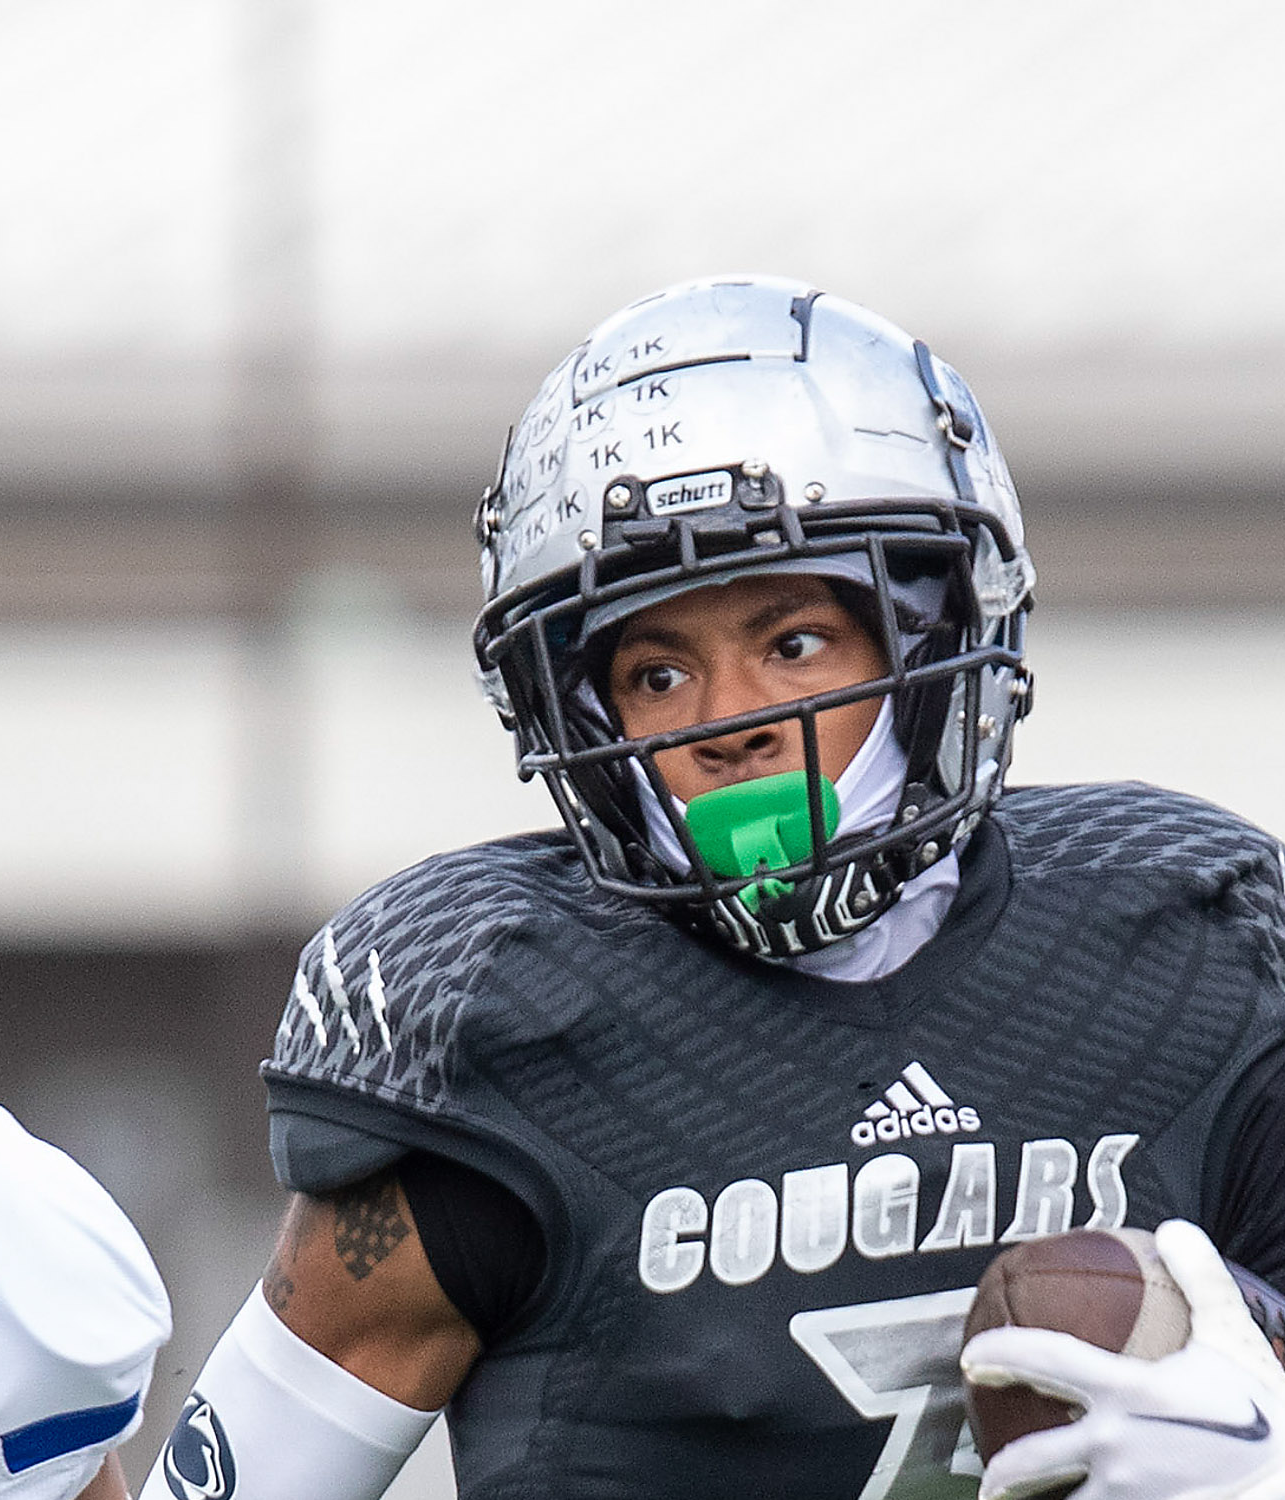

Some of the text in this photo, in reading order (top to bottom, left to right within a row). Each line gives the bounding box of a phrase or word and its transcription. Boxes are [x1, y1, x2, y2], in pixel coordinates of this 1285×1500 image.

[580, 336, 663, 383] 1K 1K
[571, 402, 605, 431] 1K
[632, 377, 669, 402] 1K
[539, 421, 683, 475] 1K 1K 1K
[556, 490, 582, 523] 1K
[850, 1102, 982, 1147] adidas
[638, 1132, 1140, 1294] COUGARS
